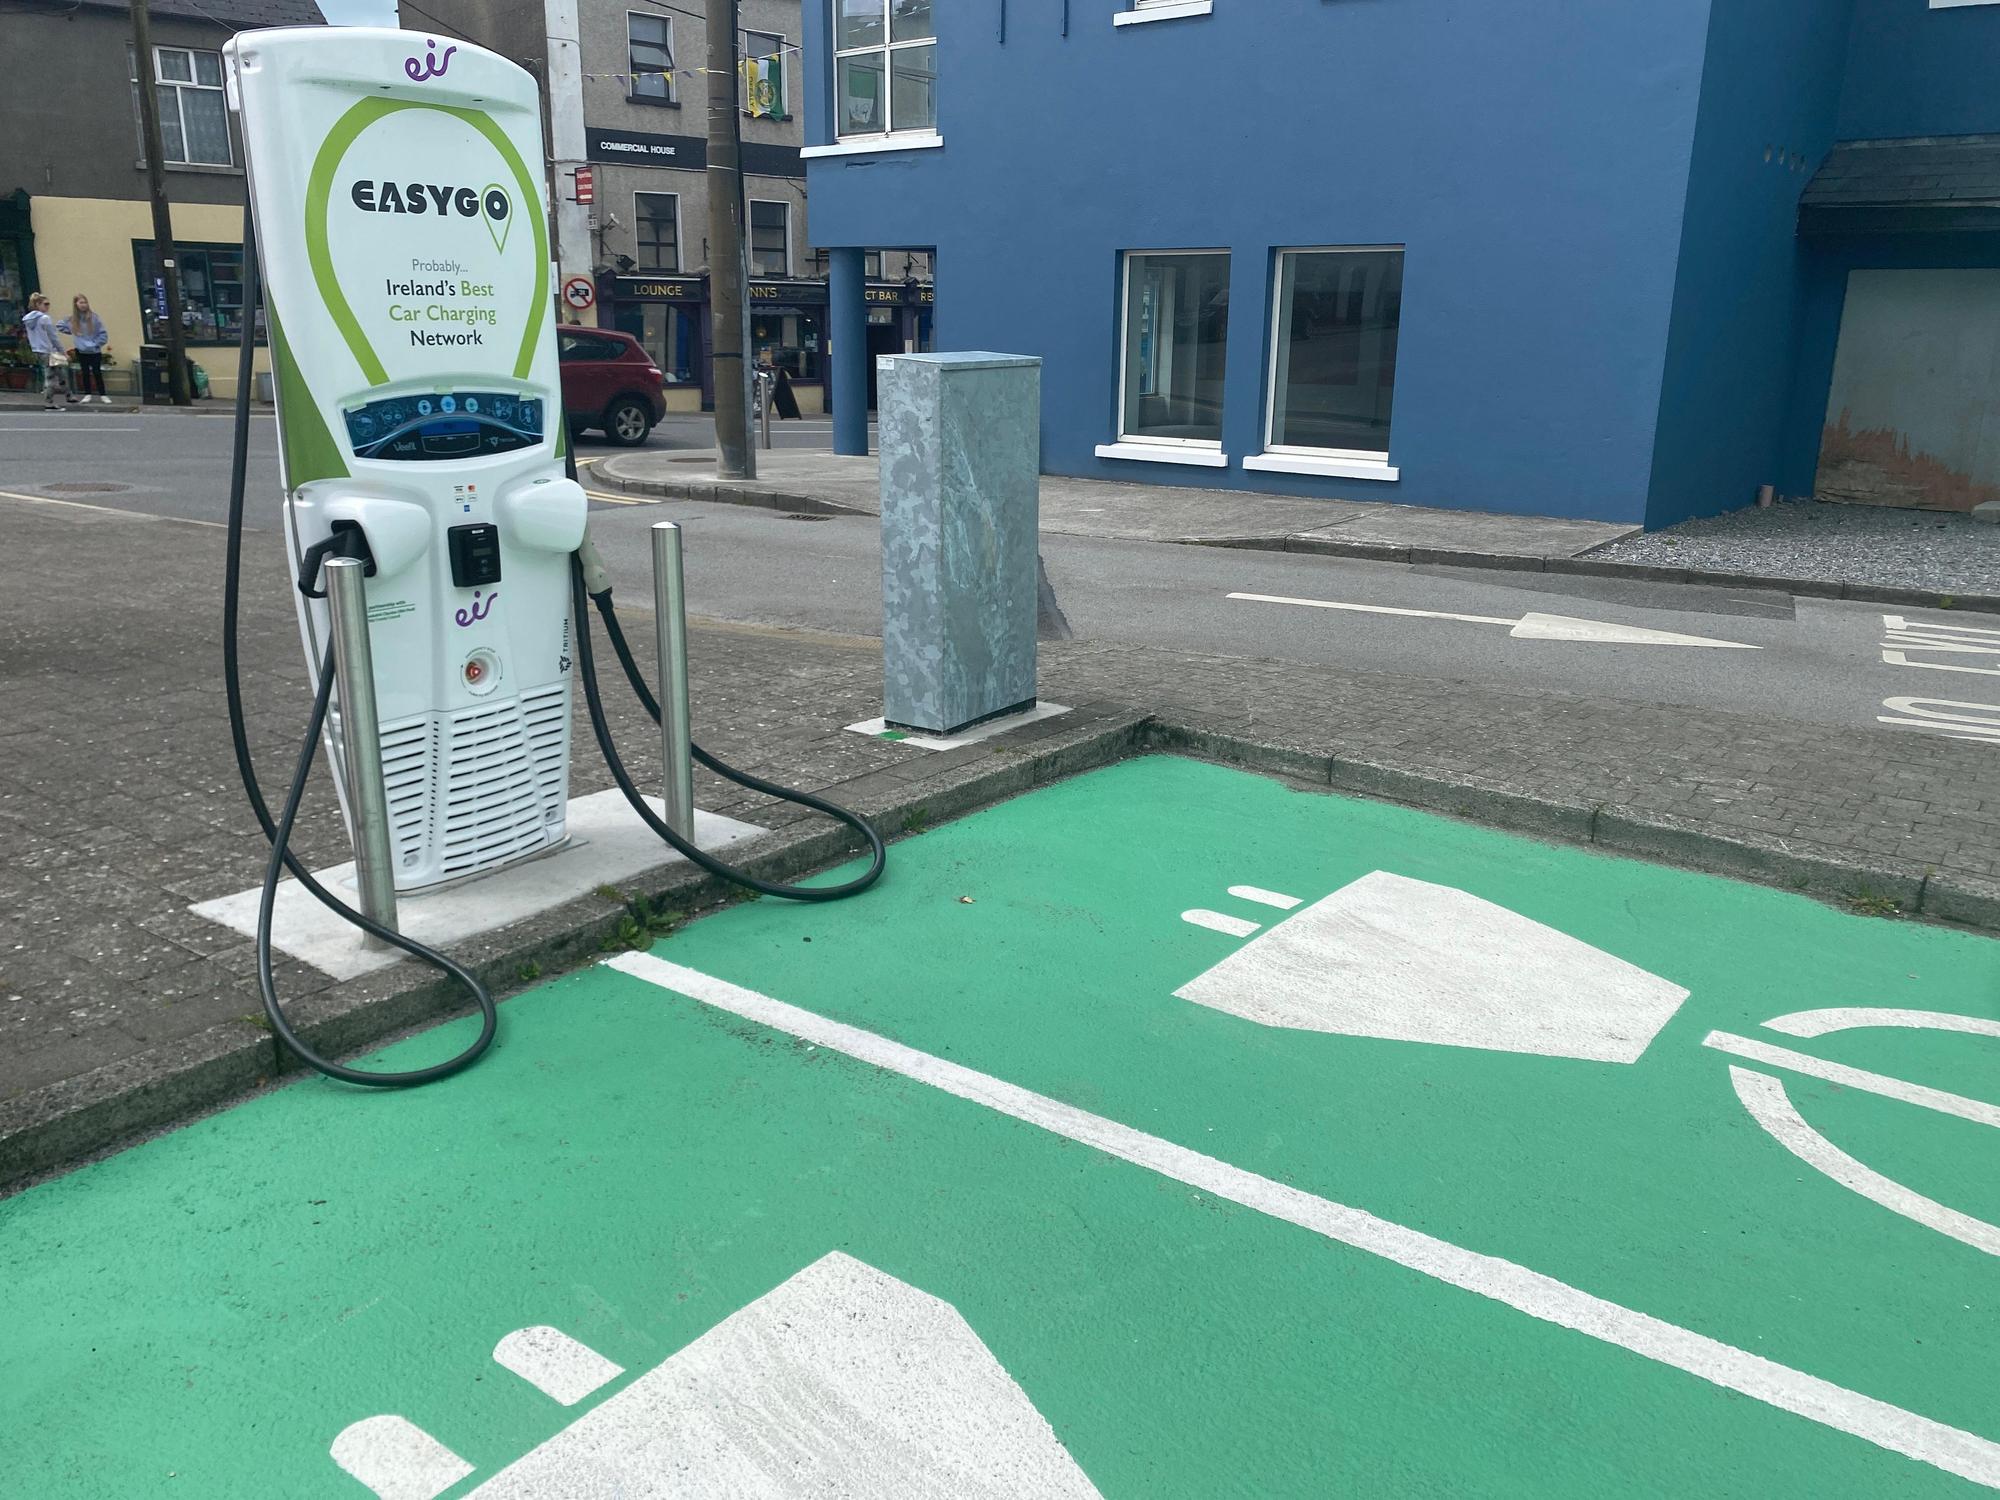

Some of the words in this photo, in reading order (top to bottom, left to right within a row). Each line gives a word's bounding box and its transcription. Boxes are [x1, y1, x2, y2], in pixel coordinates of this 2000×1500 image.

[404, 38, 457, 82] eir
[600, 141, 649, 153] COMMERCIAL
[650, 145, 676, 155] HOUSE
[351, 180, 509, 221] EASYGO
[412, 258, 469, 276] Probably...
[386, 279, 456, 296] Ireland's
[461, 280, 494, 297] Best
[633, 284, 682, 296] LOUNGE
[879, 291, 898, 301] BAR
[389, 304, 421, 321] Car
[426, 304, 498, 326] Charging
[410, 329, 484, 346] Network
[455, 590, 498, 627] eir
